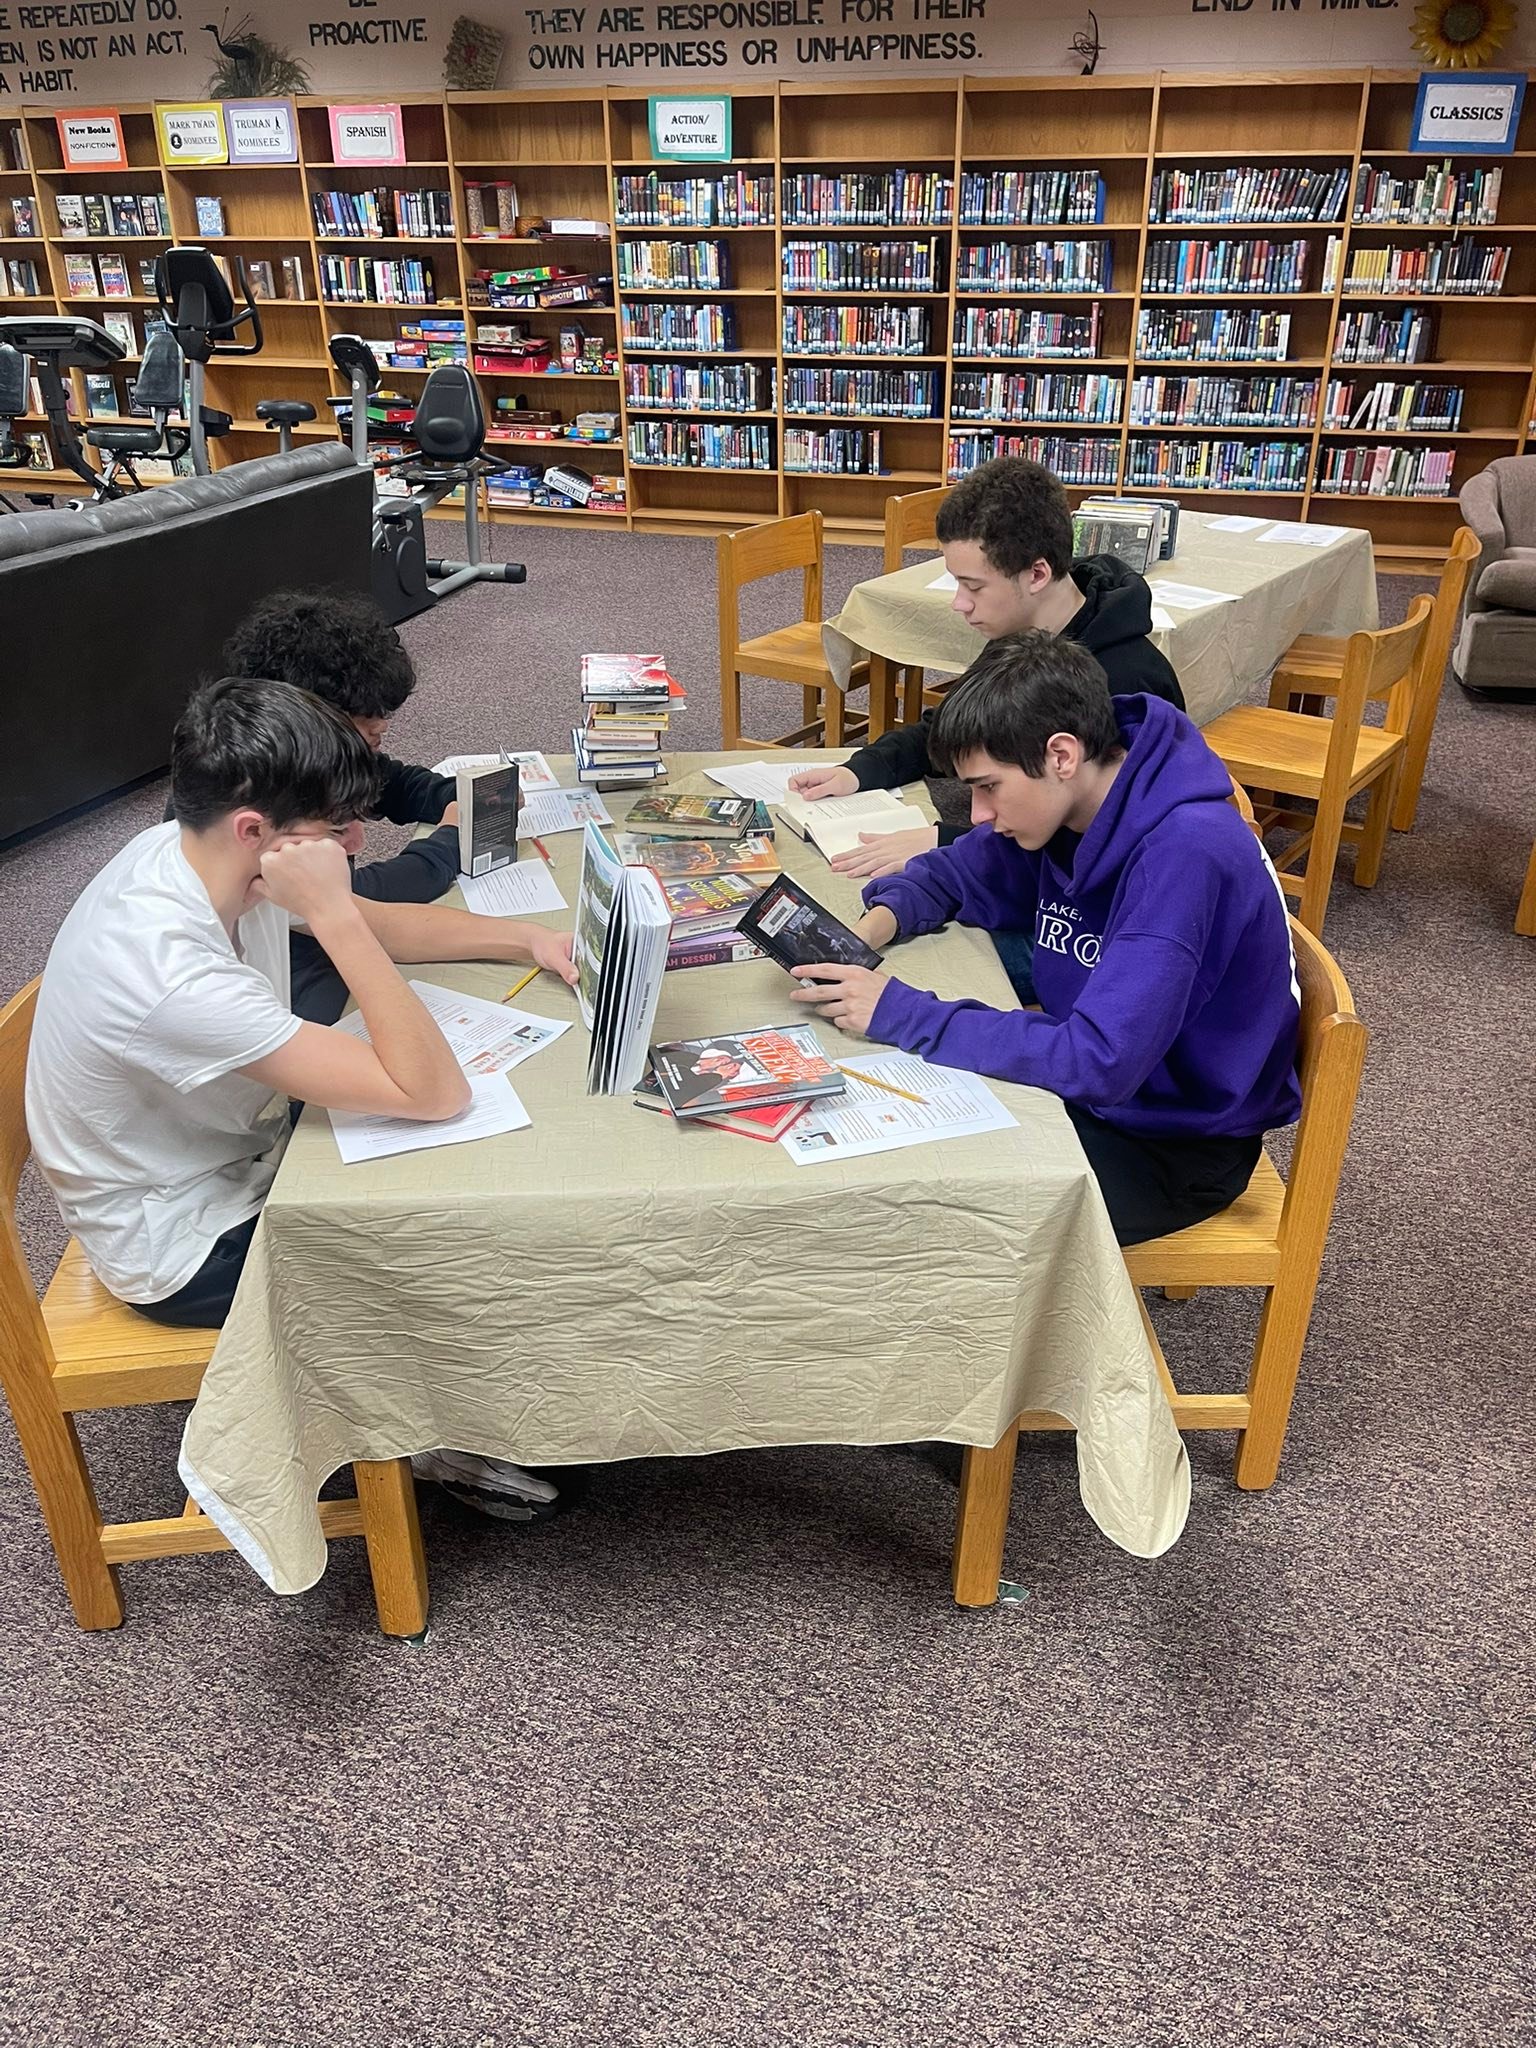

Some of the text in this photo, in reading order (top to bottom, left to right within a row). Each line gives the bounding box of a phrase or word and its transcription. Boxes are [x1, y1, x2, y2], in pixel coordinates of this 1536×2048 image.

[19, 0, 136, 29] REPEATEDLY
[147, 0, 182, 21] DO.
[525, 0, 985, 34] THEY ARE RESPONSIBLE FOR THEIR
[308, 18, 428, 46] PROACTIVE.
[37, 39, 55, 62] IS
[59, 36, 98, 60] NOT
[108, 34, 136, 57] AN
[147, 31, 187, 55] ACT,
[529, 31, 983, 69] OWN HAPPINESS OR UNHAPPINESS.
[19, 69, 78, 93] HABIT.
[671, 114, 710, 125] ACTION/
[1430, 106, 1504, 120] CLASSICS
[68, 126, 111, 135] New Books
[169, 119, 216, 130] MARK TWAIN
[235, 119, 271, 129] TRUMAN
[346, 126, 387, 138] SPANISH
[663, 133, 718, 144] ADVENTURE
[183, 136, 218, 145] NOMINEES
[238, 137, 281, 147] NOMINEES
[726, 843, 755, 864] Stay
[1039, 898, 1083, 922] LAKE
[681, 953, 717, 966] DESSEN
[743, 1037, 802, 1082] SALEM?
